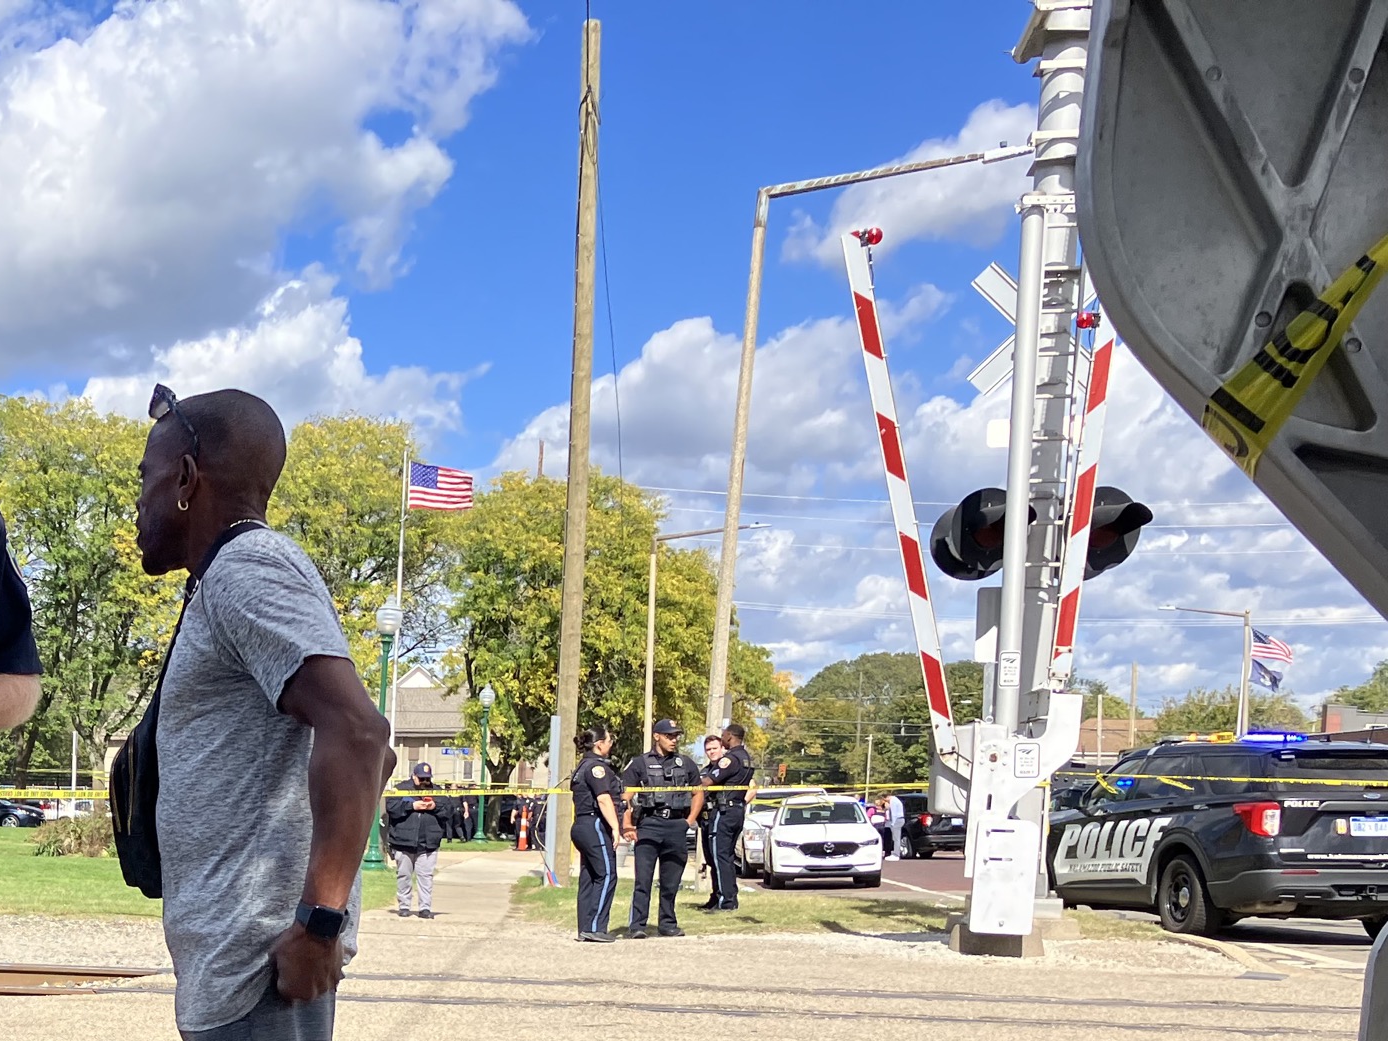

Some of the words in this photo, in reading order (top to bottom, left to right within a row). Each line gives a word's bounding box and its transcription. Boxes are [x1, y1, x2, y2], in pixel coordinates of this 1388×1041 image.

[1284, 800, 1320, 808] POLICE
[1060, 817, 1172, 859] POLICE
[1101, 863, 1120, 873] PUBLIC
[1121, 862, 1143, 873] SAFETY
